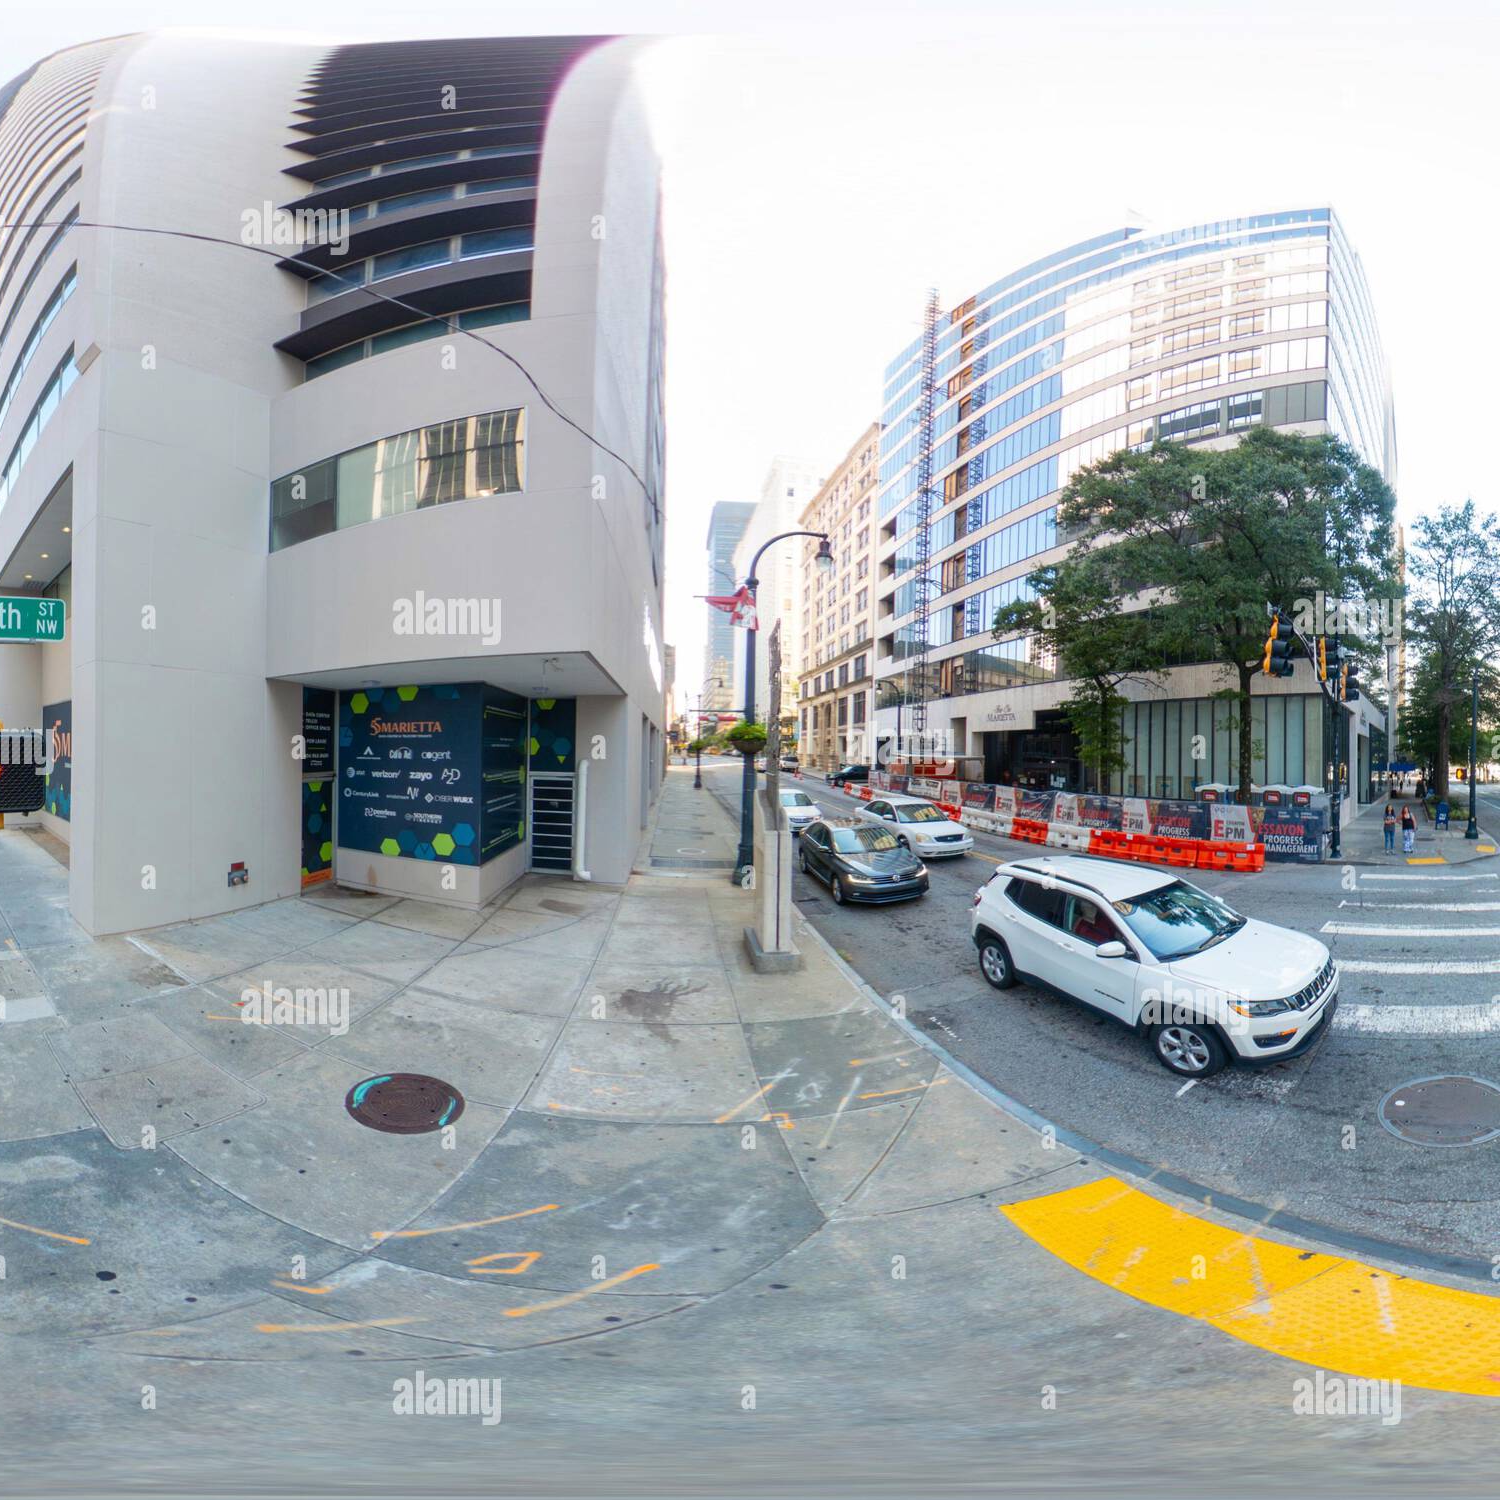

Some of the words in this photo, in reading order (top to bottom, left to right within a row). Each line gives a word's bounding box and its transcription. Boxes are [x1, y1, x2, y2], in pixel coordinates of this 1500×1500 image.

[38, 602, 55, 617] ST
[36, 619, 57, 634] NW
[383, 721, 442, 733] MARIETTA
[421, 750, 451, 762] cogent
[409, 771, 432, 781] zayo
[1157, 826, 1189, 837] PROGRESS
[1259, 824, 1305, 836] ESSAYON
[1263, 834, 1303, 845] PROGRESS
[1264, 844, 1318, 854] MANAGEMENT
